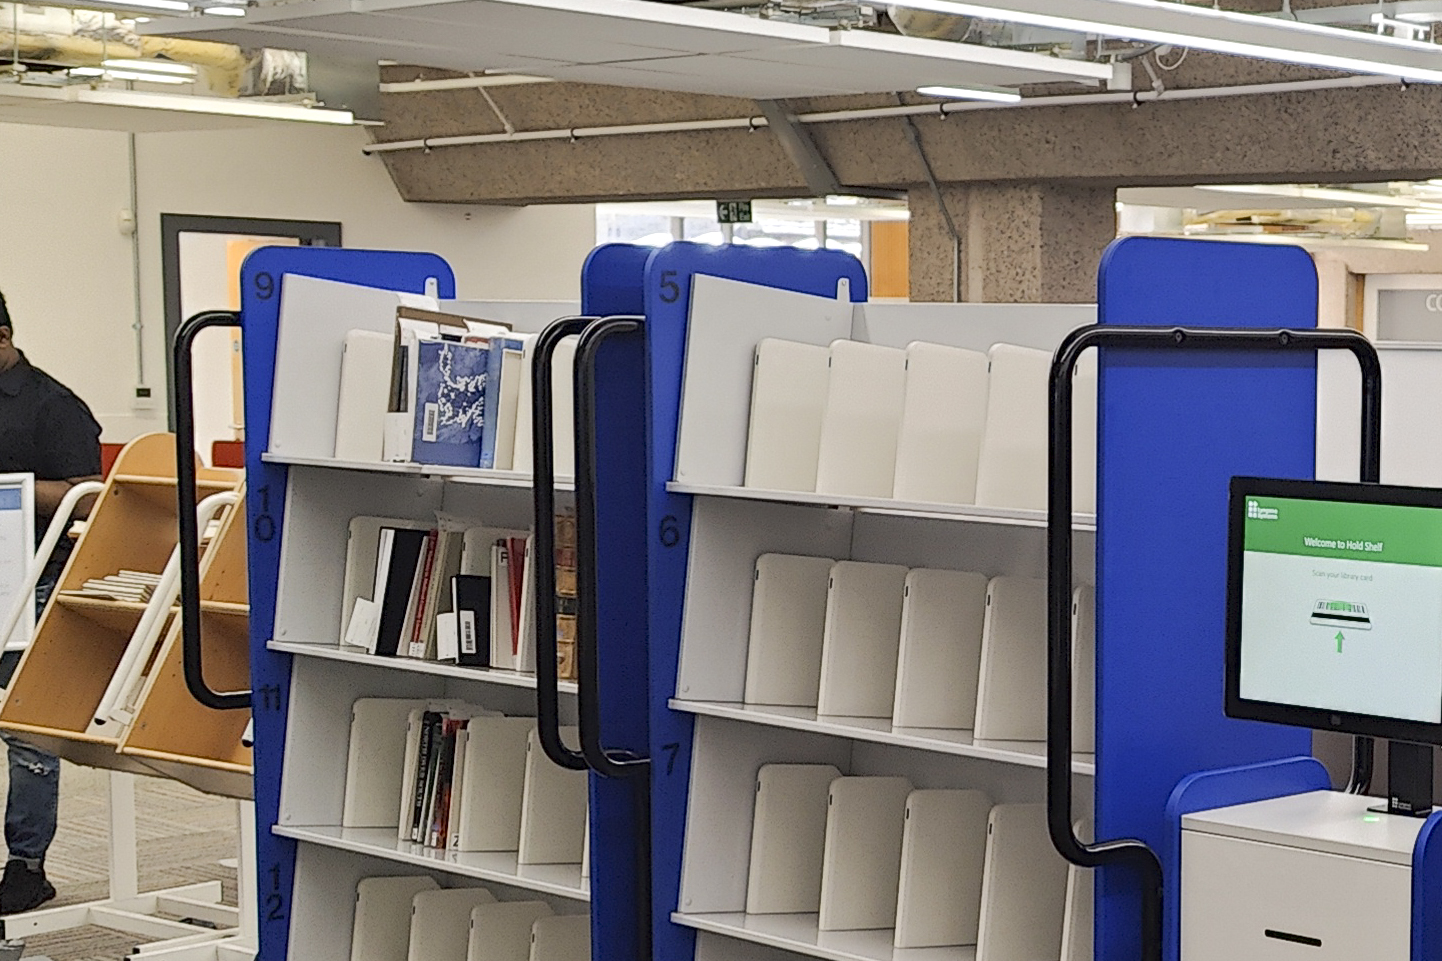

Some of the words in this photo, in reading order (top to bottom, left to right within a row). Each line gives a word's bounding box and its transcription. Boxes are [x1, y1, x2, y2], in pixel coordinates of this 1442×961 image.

[254, 272, 275, 301] 9
[659, 271, 680, 303] 5
[255, 485, 276, 542] 10
[659, 516, 680, 547] 6
[1303, 537, 1337, 549] Welcome
[1337, 540, 1345, 549] to
[1346, 541, 1364, 551] Hold
[1364, 541, 1383, 552] Shelf
[1312, 569, 1326, 578] Scan
[1326, 572, 1340, 580] your
[1340, 571, 1359, 581] library
[1359, 574, 1373, 582] card
[261, 683, 281, 711] 11
[662, 743, 681, 776] 7
